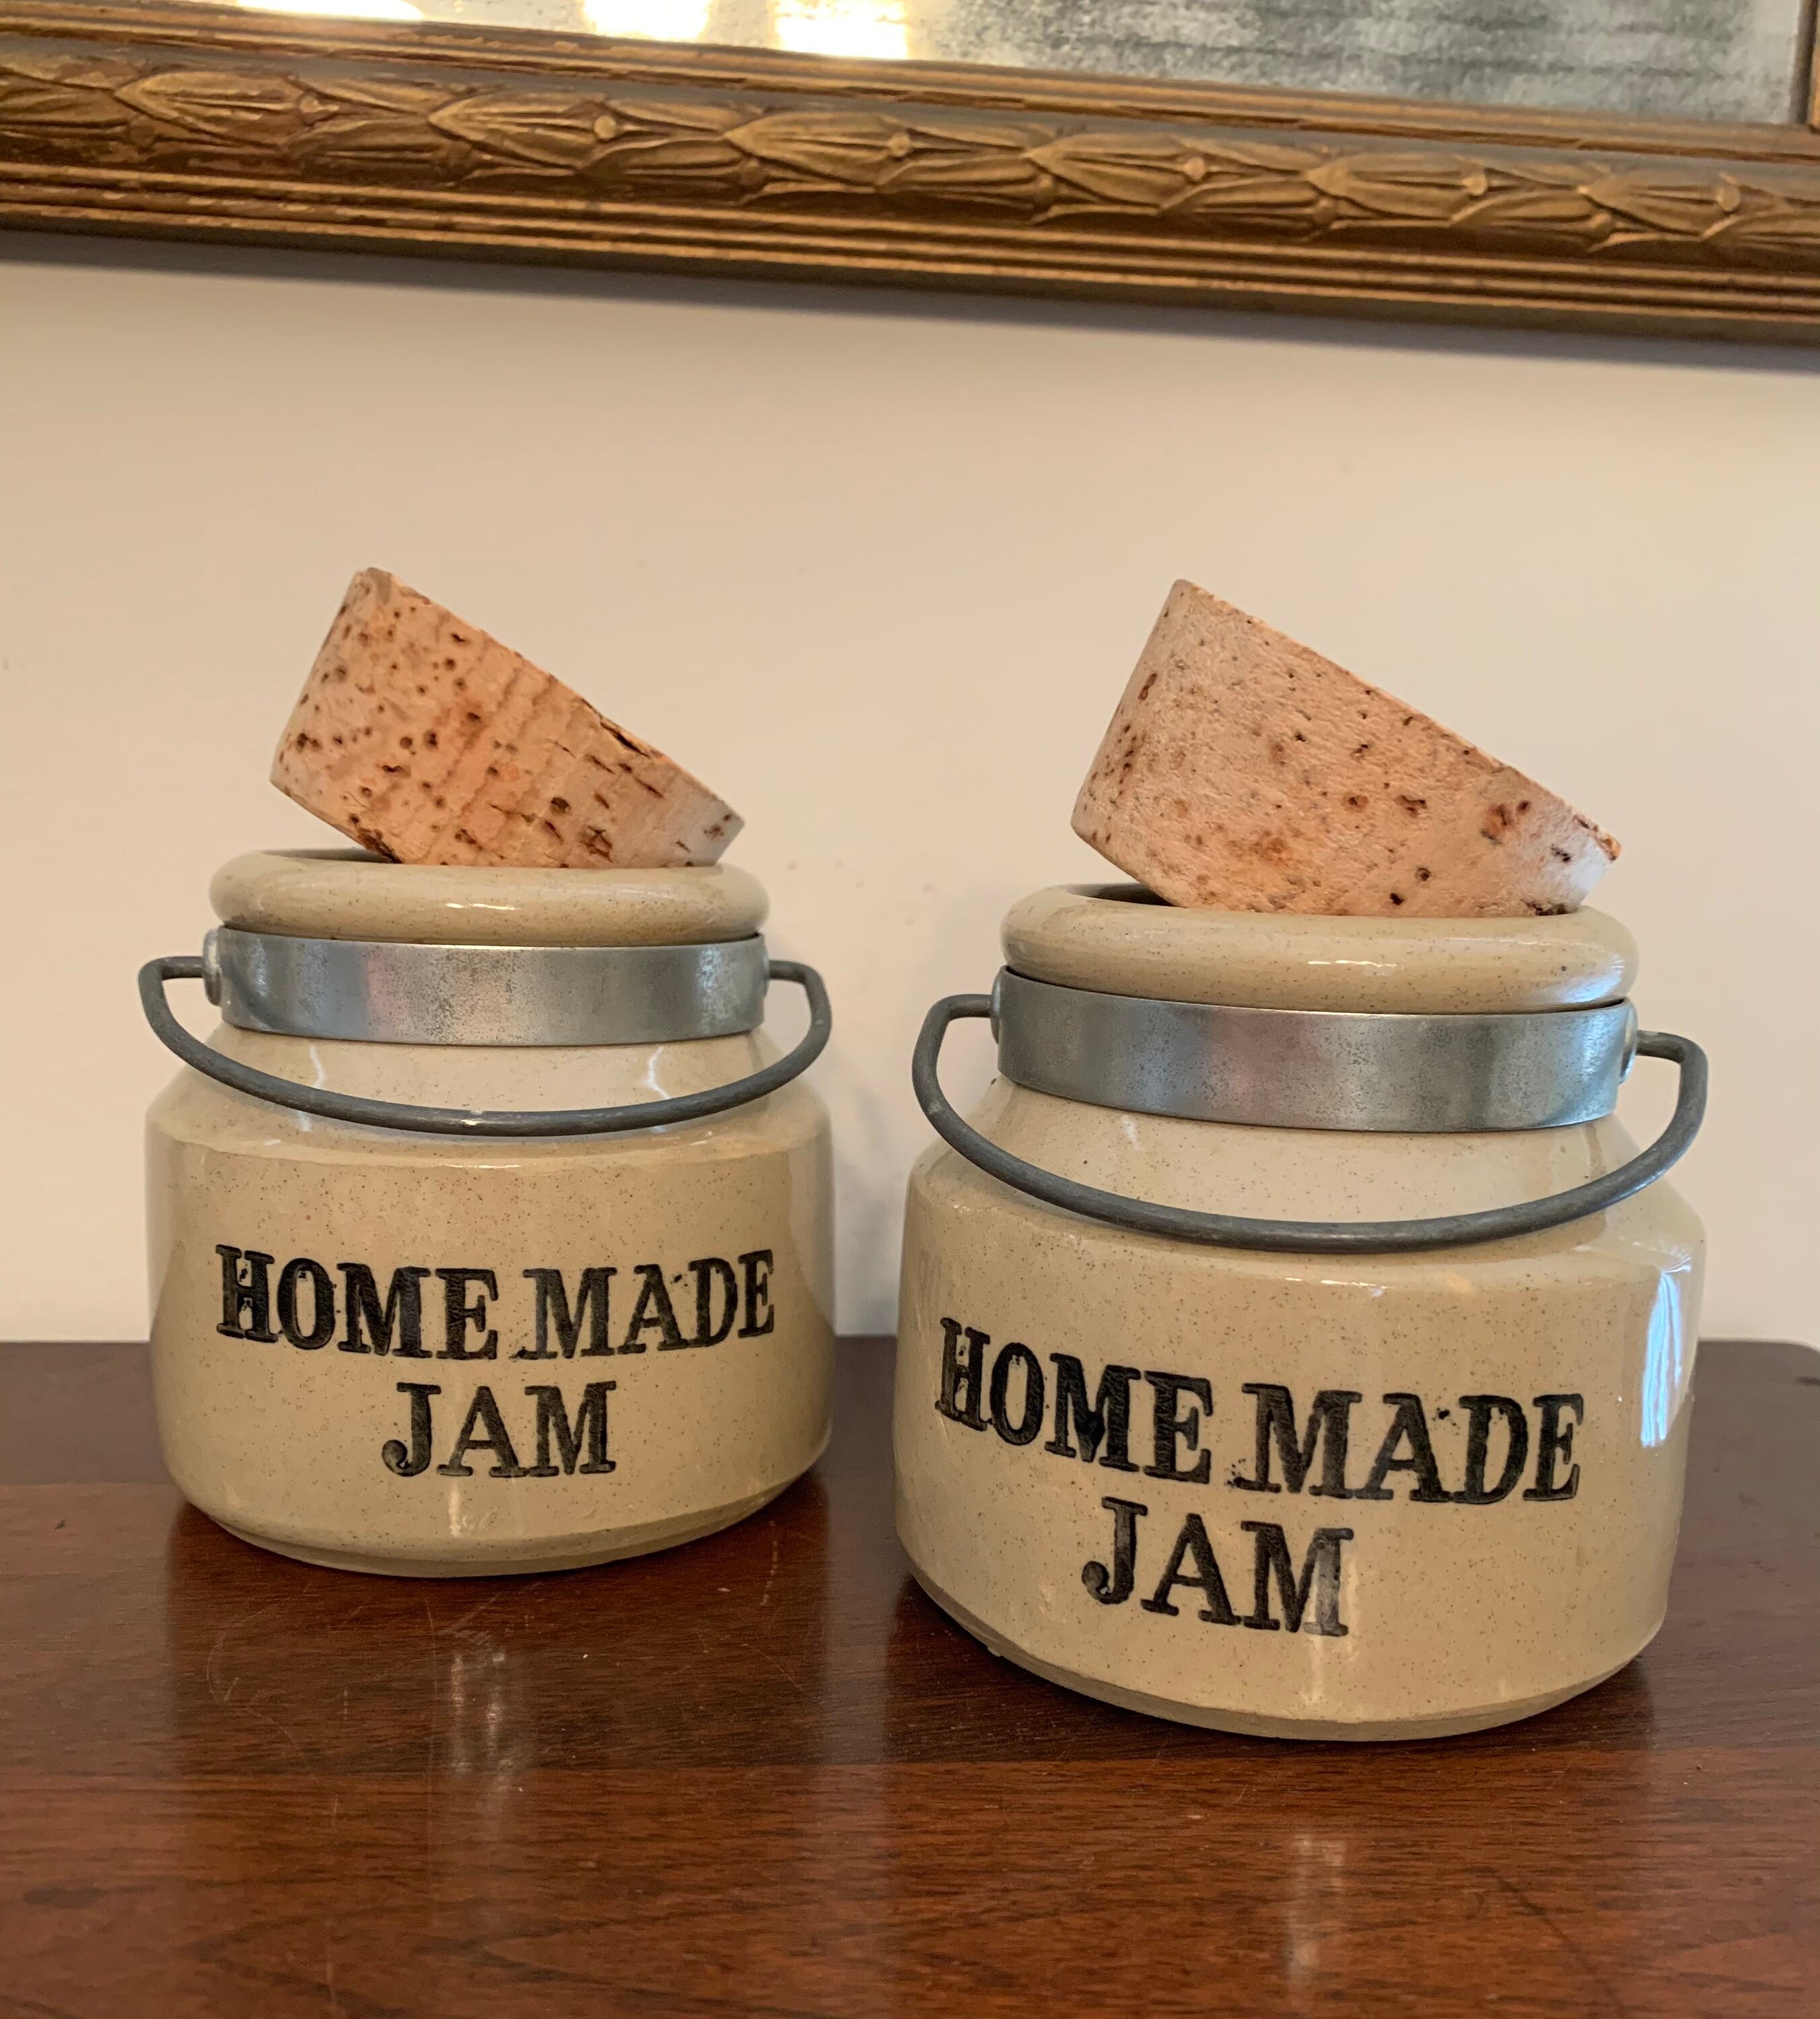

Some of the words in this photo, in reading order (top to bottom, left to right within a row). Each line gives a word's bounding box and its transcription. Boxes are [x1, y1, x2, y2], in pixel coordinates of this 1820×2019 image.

[215, 1244, 498, 1361] HOME
[517, 1249, 775, 1360] MADE
[381, 1380, 617, 1478] JAM
[934, 1317, 1212, 1484] HOME
[1233, 1382, 1584, 1505] MADE
[1081, 1496, 1354, 1637] JAM
